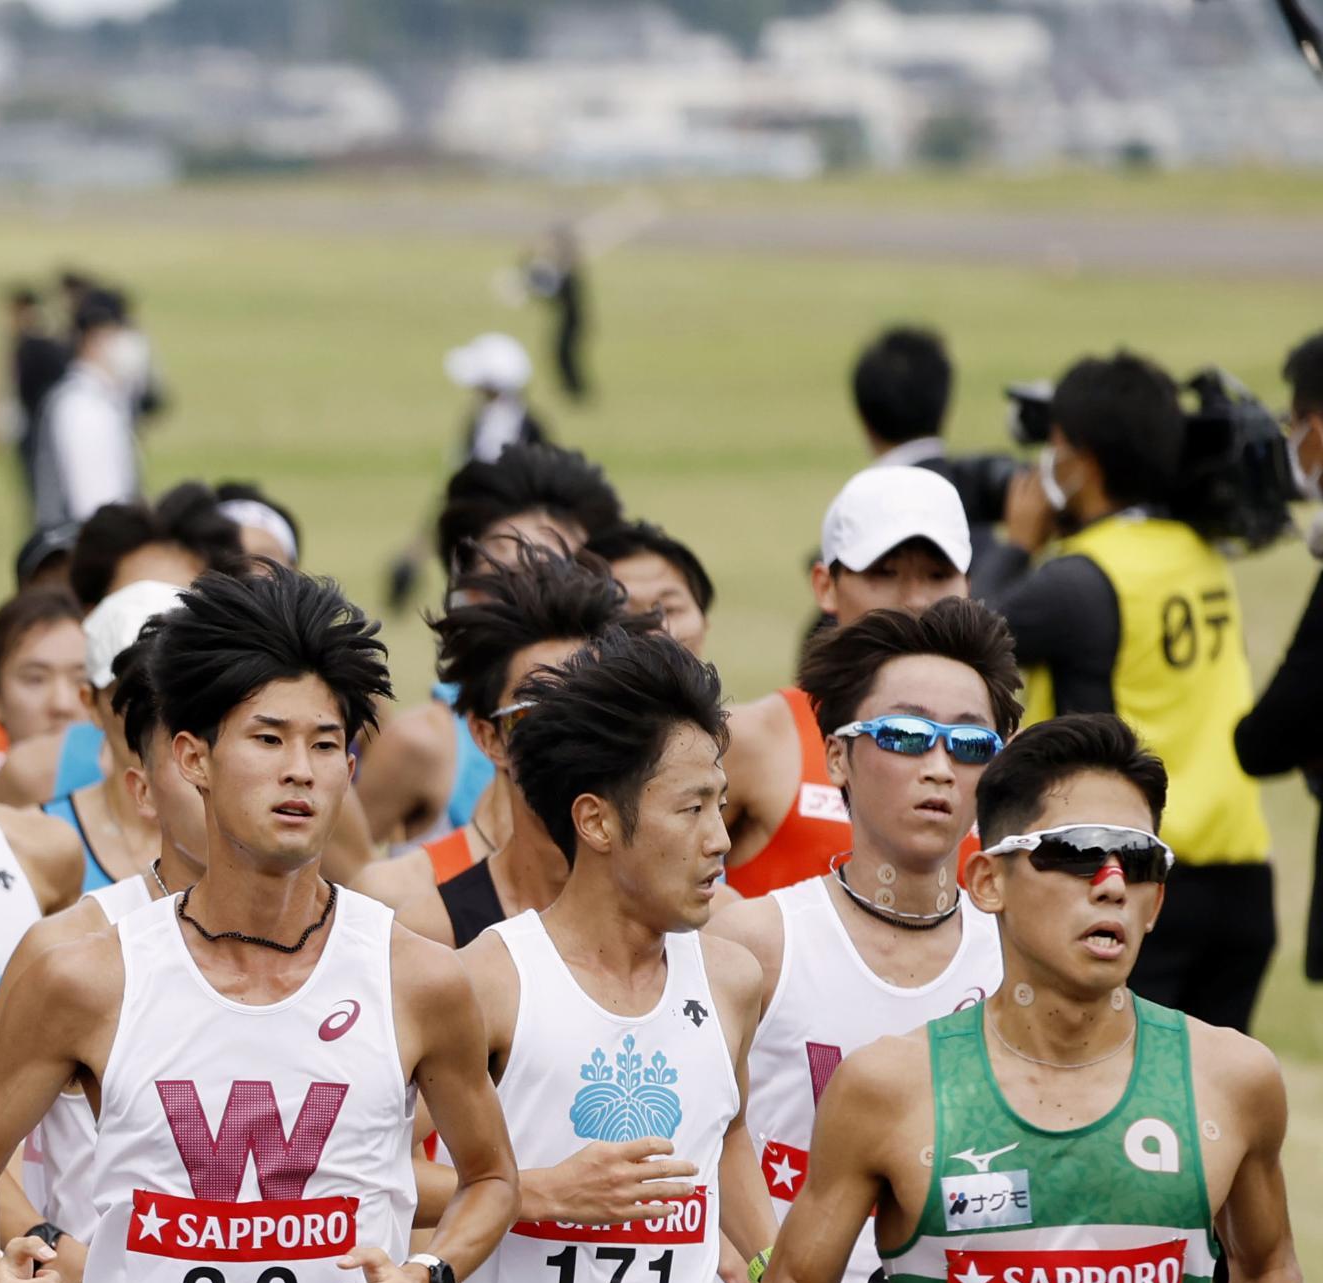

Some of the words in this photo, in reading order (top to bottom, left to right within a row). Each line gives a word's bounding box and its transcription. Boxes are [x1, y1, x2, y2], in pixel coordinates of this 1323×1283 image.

[154, 1079, 350, 1203] W
[971, 1190, 1028, 1214] ナグモ
[177, 1210, 349, 1250] SAPPORO
